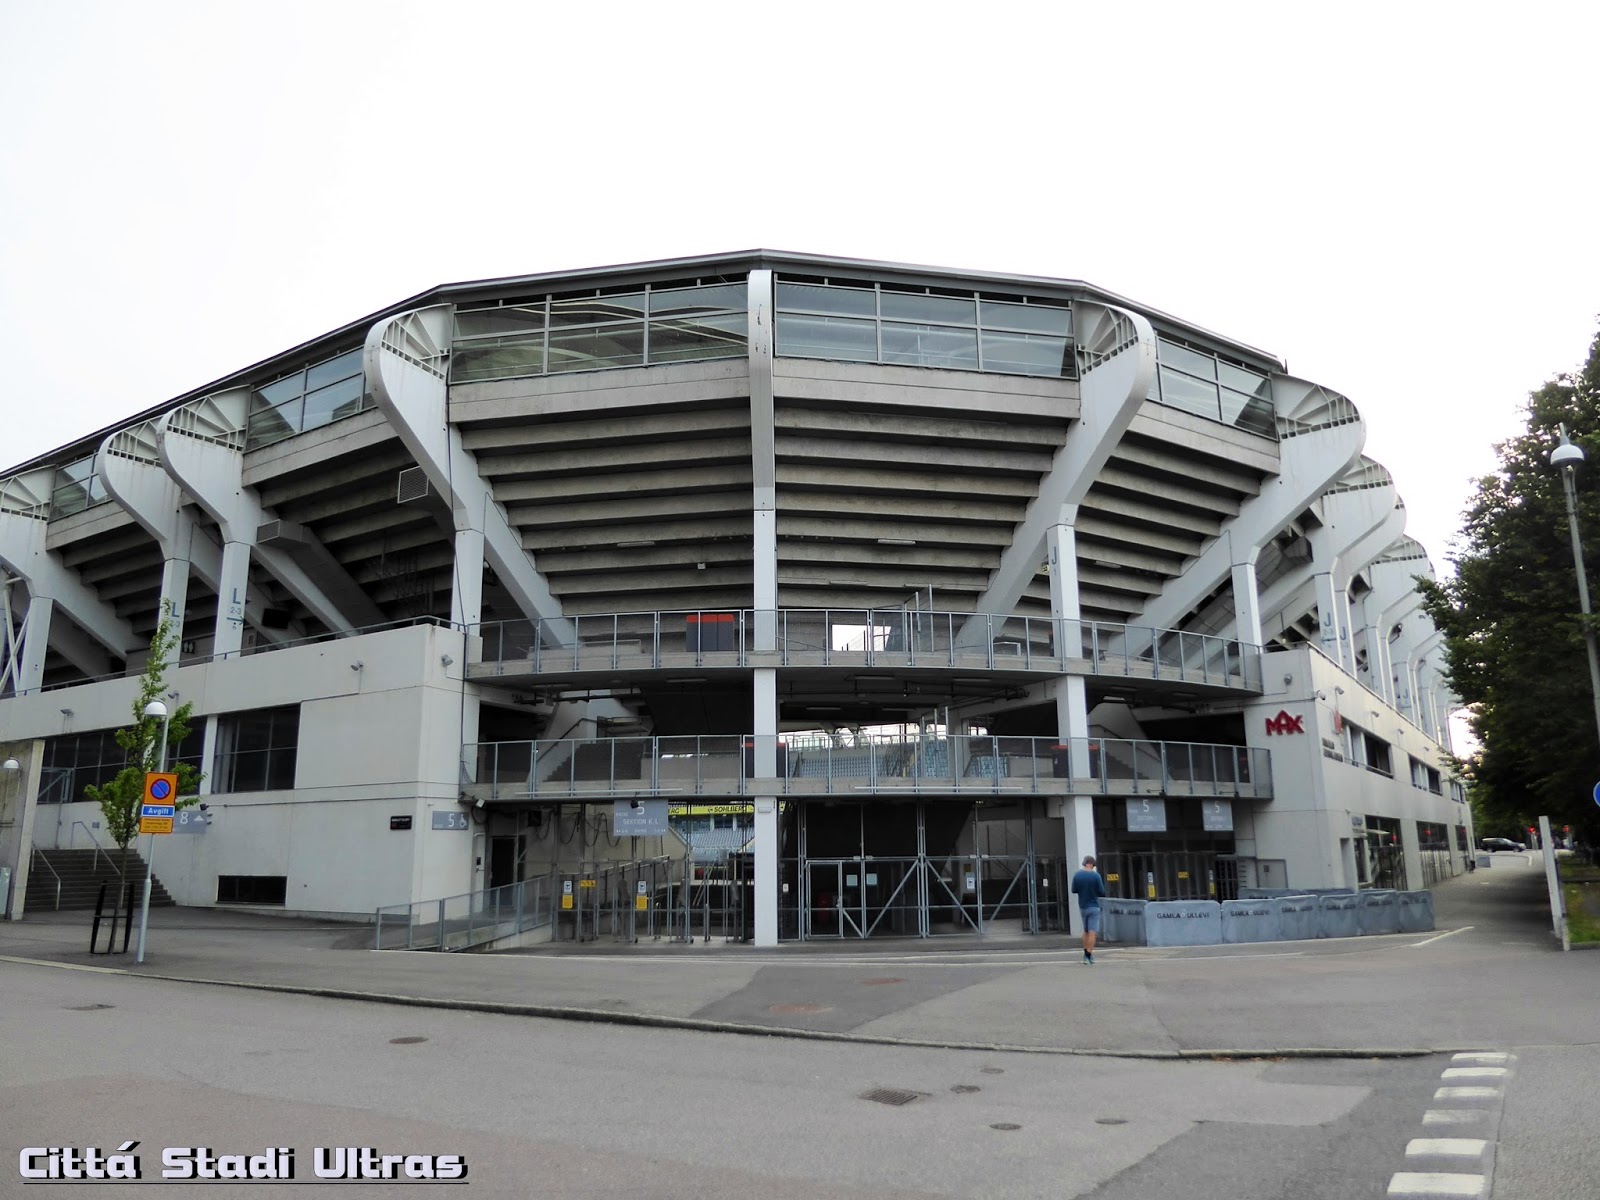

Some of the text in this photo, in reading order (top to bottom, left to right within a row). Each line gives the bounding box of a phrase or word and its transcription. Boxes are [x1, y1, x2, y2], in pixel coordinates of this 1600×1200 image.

[232, 587, 241, 605] L
[171, 601, 180, 618] L
[1324, 612, 1331, 627] J
[1340, 627, 1347, 640] J
[1265, 709, 1304, 736] MAX
[148, 807, 169, 815] Avgift
[636, 800, 645, 815] 5
[1142, 799, 1150, 812] 5
[1214, 800, 1220, 813] 5
[180, 811, 188, 824] 8
[448, 813, 455, 827] 5
